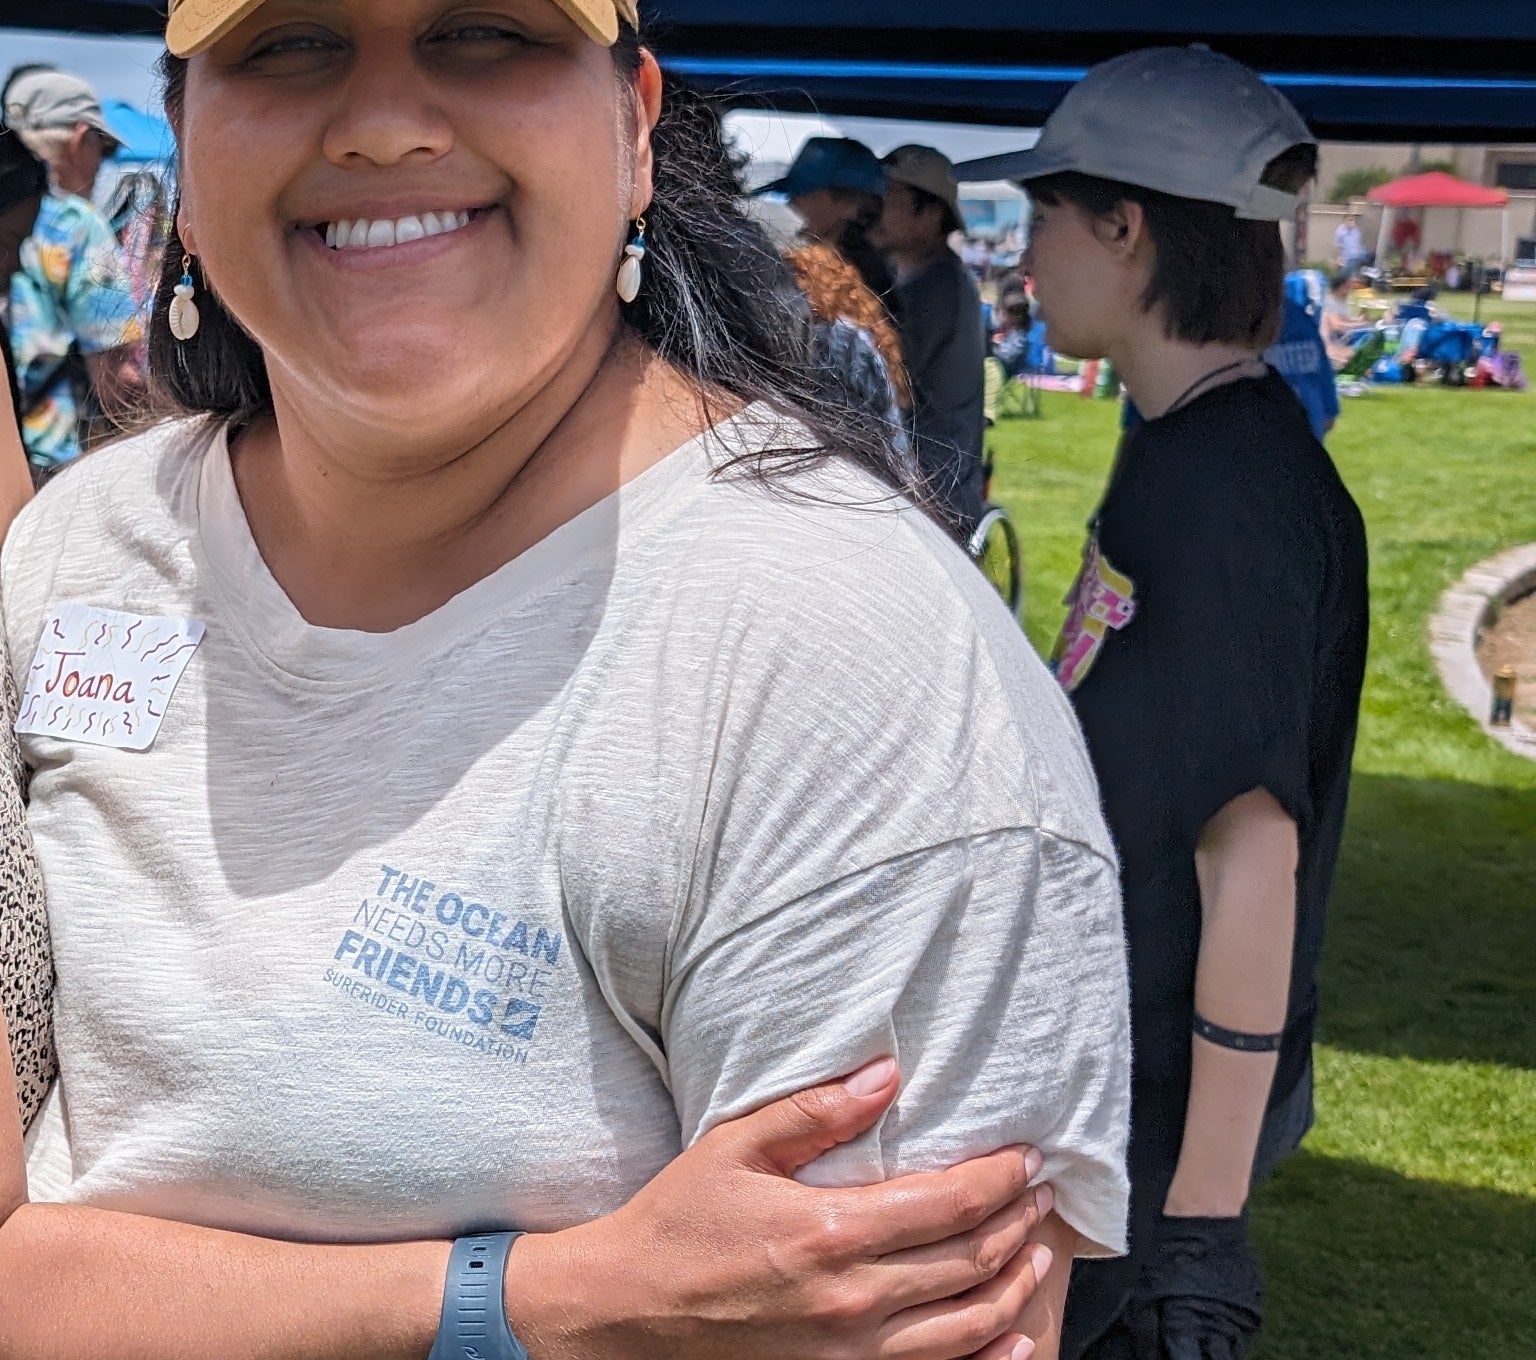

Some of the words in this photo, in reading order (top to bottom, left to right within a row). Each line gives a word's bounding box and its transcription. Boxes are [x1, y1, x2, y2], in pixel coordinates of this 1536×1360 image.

[45, 650, 136, 704] Joana
[353, 899, 451, 960] NEEDS
[454, 941, 553, 998] MORE
[376, 864, 435, 914] THE
[435, 892, 562, 965] OCEAN
[323, 968, 409, 1020] SURFRIDER
[414, 1011, 530, 1064] FOUNDATION
[333, 930, 498, 1027] FRIENDS
